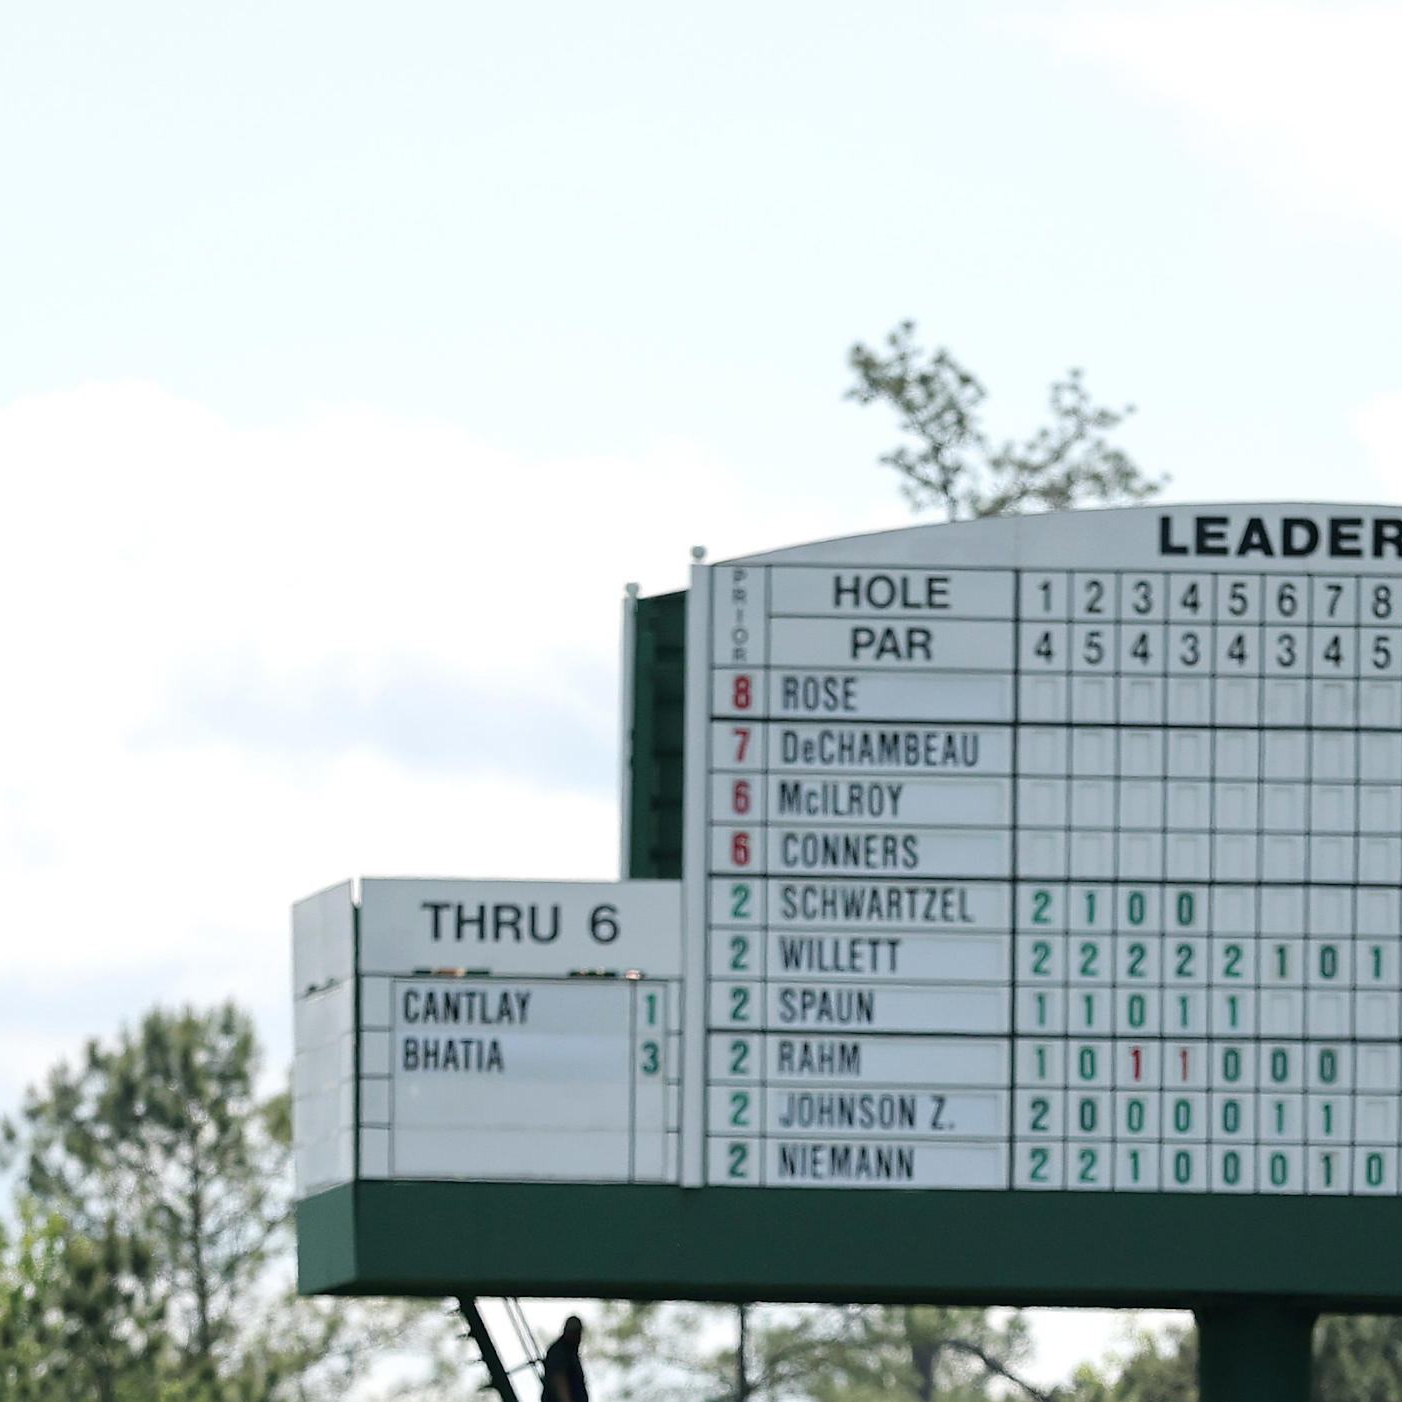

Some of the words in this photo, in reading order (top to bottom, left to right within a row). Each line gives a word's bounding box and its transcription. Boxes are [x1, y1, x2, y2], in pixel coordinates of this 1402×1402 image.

[731, 567, 751, 663] PRIOR
[834, 574, 951, 610] HOLE
[1037, 580, 1053, 612] 1
[1084, 579, 1105, 614] 2
[1131, 580, 1154, 616] 3
[1179, 582, 1202, 614] 4
[1227, 581, 1250, 617] 5
[1276, 582, 1299, 618] 6
[1324, 583, 1344, 617] 7
[1370, 583, 1394, 620] 8
[851, 626, 932, 661] PAR
[1033, 631, 1055, 662] 4
[1082, 630, 1106, 666] 5
[1129, 632, 1151, 664] 4
[1178, 631, 1202, 667] 3
[1226, 633, 1248, 665] 4
[1275, 633, 1298, 669] 3
[1322, 635, 1344, 667] 4
[1371, 635, 1393, 670] 5
[732, 675, 752, 710] 8
[782, 675, 857, 712] ROSE
[732, 727, 752, 763] 7
[782, 729, 978, 767] DeCHAMBEAU
[732, 779, 751, 815] 6
[778, 779, 903, 817] McILROY
[731, 831, 751, 867] 6
[782, 832, 919, 869] CONNERS
[421, 902, 560, 944] THRU
[588, 904, 621, 945] 6
[730, 883, 752, 919] 2
[781, 883, 975, 923] SCHWARTZEL
[1030, 889, 1053, 925] 2
[1084, 890, 1097, 925] 1
[1126, 890, 1147, 926] 0
[1175, 891, 1196, 927] 0
[728, 935, 750, 971] 2
[779, 936, 901, 973] WILLETT
[1030, 940, 1053, 976] 2
[1078, 941, 1100, 977] 2
[1126, 942, 1148, 978] 2
[1174, 943, 1196, 978] 2
[1222, 943, 1244, 978] 2
[1274, 944, 1288, 979] 1
[1318, 944, 1339, 980] 0
[1370, 945, 1383, 980] 1
[403, 989, 530, 1025] CANTLAY
[644, 993, 658, 1026] 1
[729, 987, 751, 1022] 2
[780, 988, 874, 1023] SPAUN
[1034, 991, 1048, 1027] 1
[1082, 993, 1095, 1028] 1
[1126, 993, 1147, 1030] 0
[1177, 995, 1191, 1029] 1
[1226, 994, 1240, 1029] 1
[403, 1037, 504, 1071] BHATIA
[641, 1041, 661, 1075] 3
[729, 1039, 751, 1075] 2
[778, 1040, 860, 1074] RAHM
[1034, 1044, 1048, 1079] 1
[1077, 1045, 1098, 1081] 0
[1130, 1046, 1143, 1081] 1
[1178, 1046, 1190, 1082] 1
[1221, 1046, 1243, 1083] 0
[1269, 1047, 1290, 1083] 0
[1317, 1048, 1339, 1085] 0
[729, 1091, 751, 1127] 2
[778, 1092, 916, 1128] JOHNSON
[929, 1093, 957, 1131] Z.
[1029, 1097, 1051, 1132] 2
[1078, 1097, 1099, 1133] 0
[1125, 1098, 1146, 1134] 0
[1172, 1098, 1193, 1134] 0
[1220, 1098, 1242, 1134] 0
[1273, 1100, 1286, 1134] 1
[1321, 1101, 1334, 1136] 1
[727, 1142, 750, 1178] 2
[780, 1145, 914, 1179] NIEMANN
[1028, 1147, 1050, 1183] 2
[1077, 1148, 1099, 1183] 2
[1128, 1149, 1141, 1183] 1
[1172, 1149, 1193, 1185] 0
[1221, 1149, 1242, 1186] 0
[1268, 1151, 1290, 1187] 0
[1320, 1152, 1334, 1188] 1
[1364, 1152, 1385, 1187] 0
